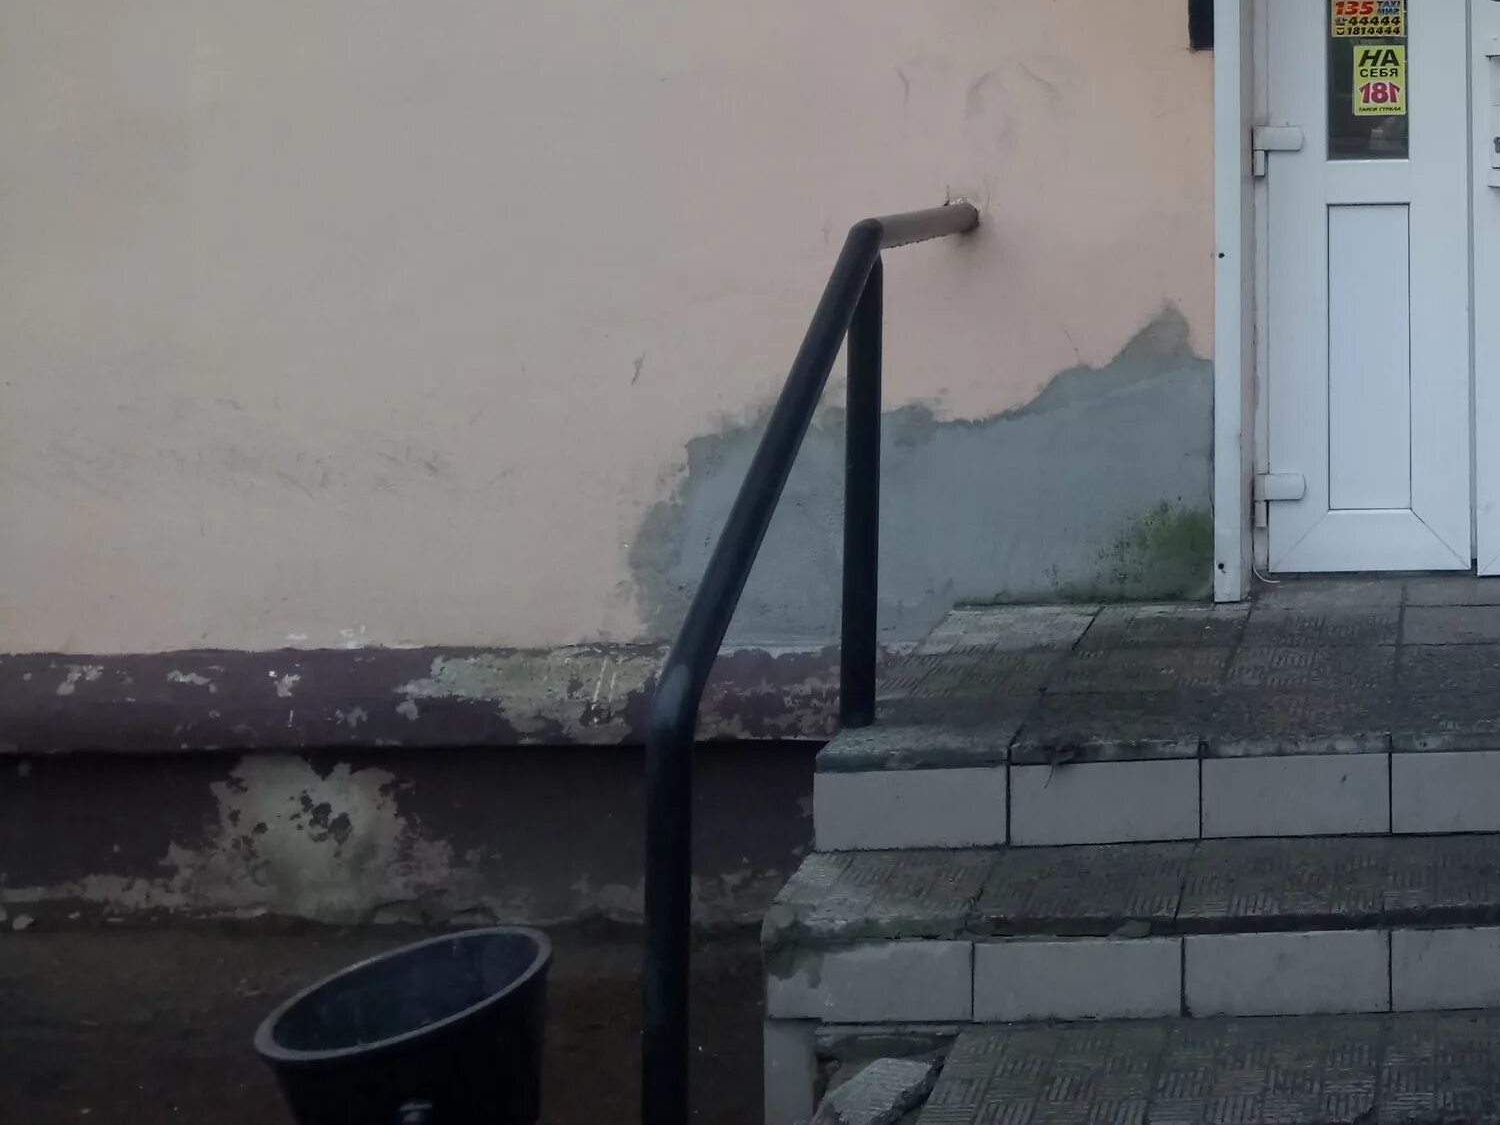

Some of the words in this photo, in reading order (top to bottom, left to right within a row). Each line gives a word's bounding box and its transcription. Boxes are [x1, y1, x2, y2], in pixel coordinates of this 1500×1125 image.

[1335, 1, 1374, 15] 135
[1348, 16, 1400, 26] 44444
[1347, 27, 1400, 35] 1814444
[1358, 49, 1400, 67] НА
[1360, 68, 1398, 78] СЕБЯ
[1359, 81, 1401, 104] 181
